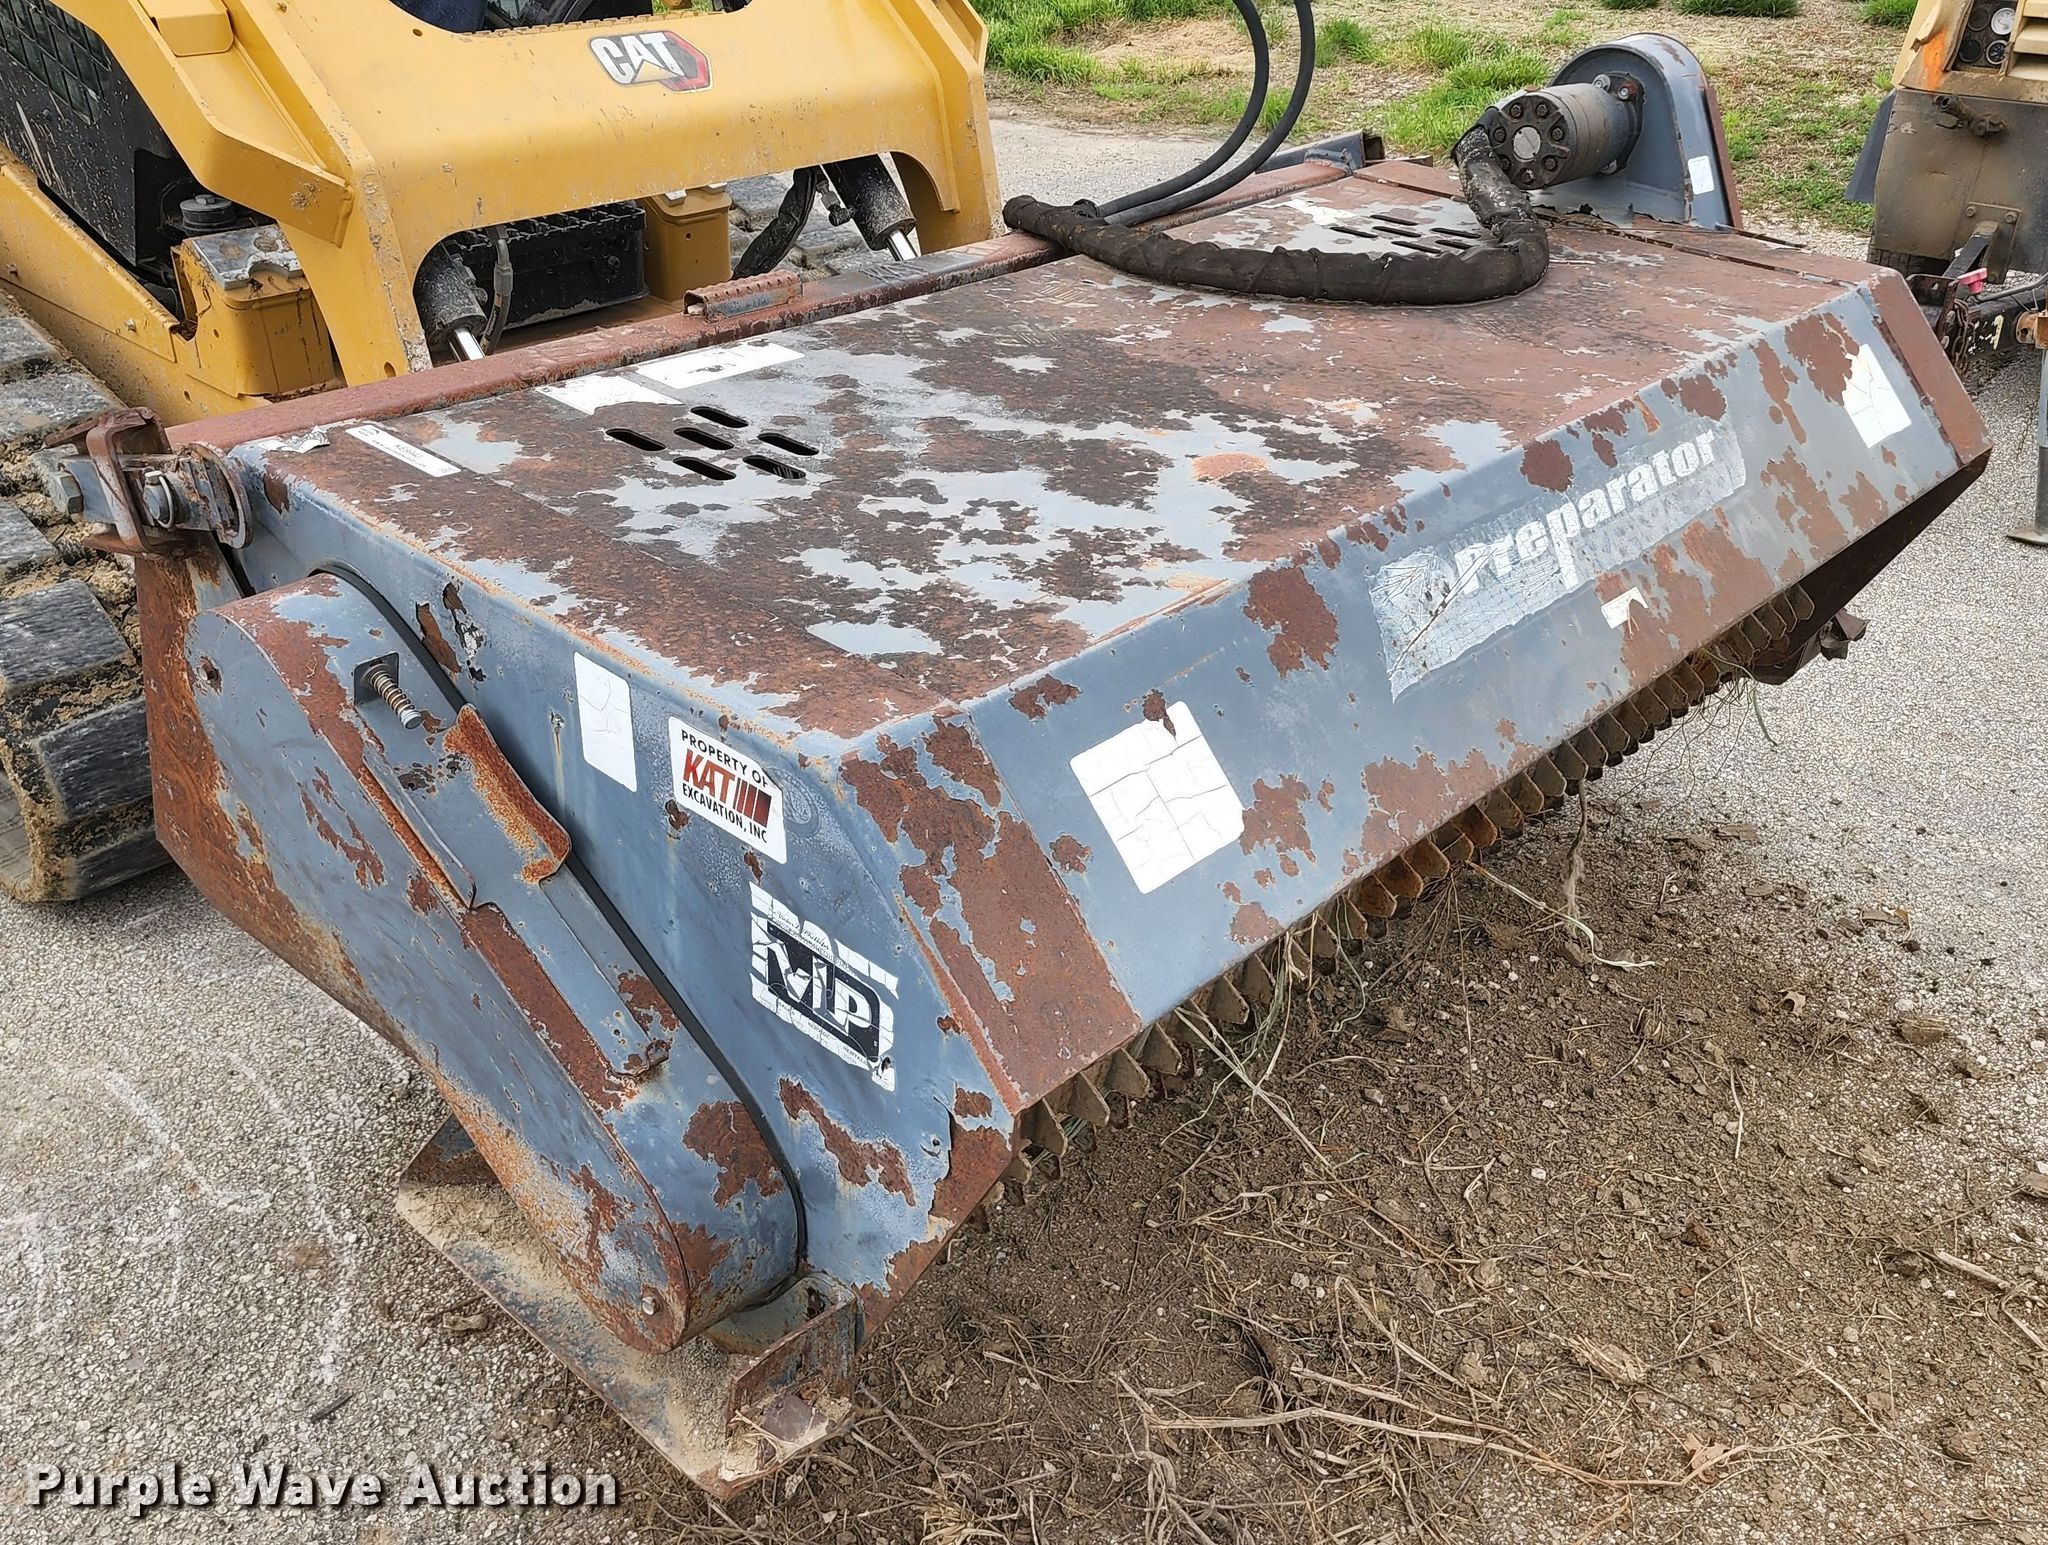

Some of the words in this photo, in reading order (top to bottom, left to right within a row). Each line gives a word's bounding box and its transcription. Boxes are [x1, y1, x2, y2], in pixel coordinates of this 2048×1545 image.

[590, 31, 686, 84] CAT
[1453, 428, 1715, 595] Preparator
[680, 729, 748, 776] PROPERTY
[751, 769, 769, 787] OF
[682, 748, 736, 804] KAT
[682, 782, 747, 833] EXCAVATION,
[749, 825, 768, 844] INC
